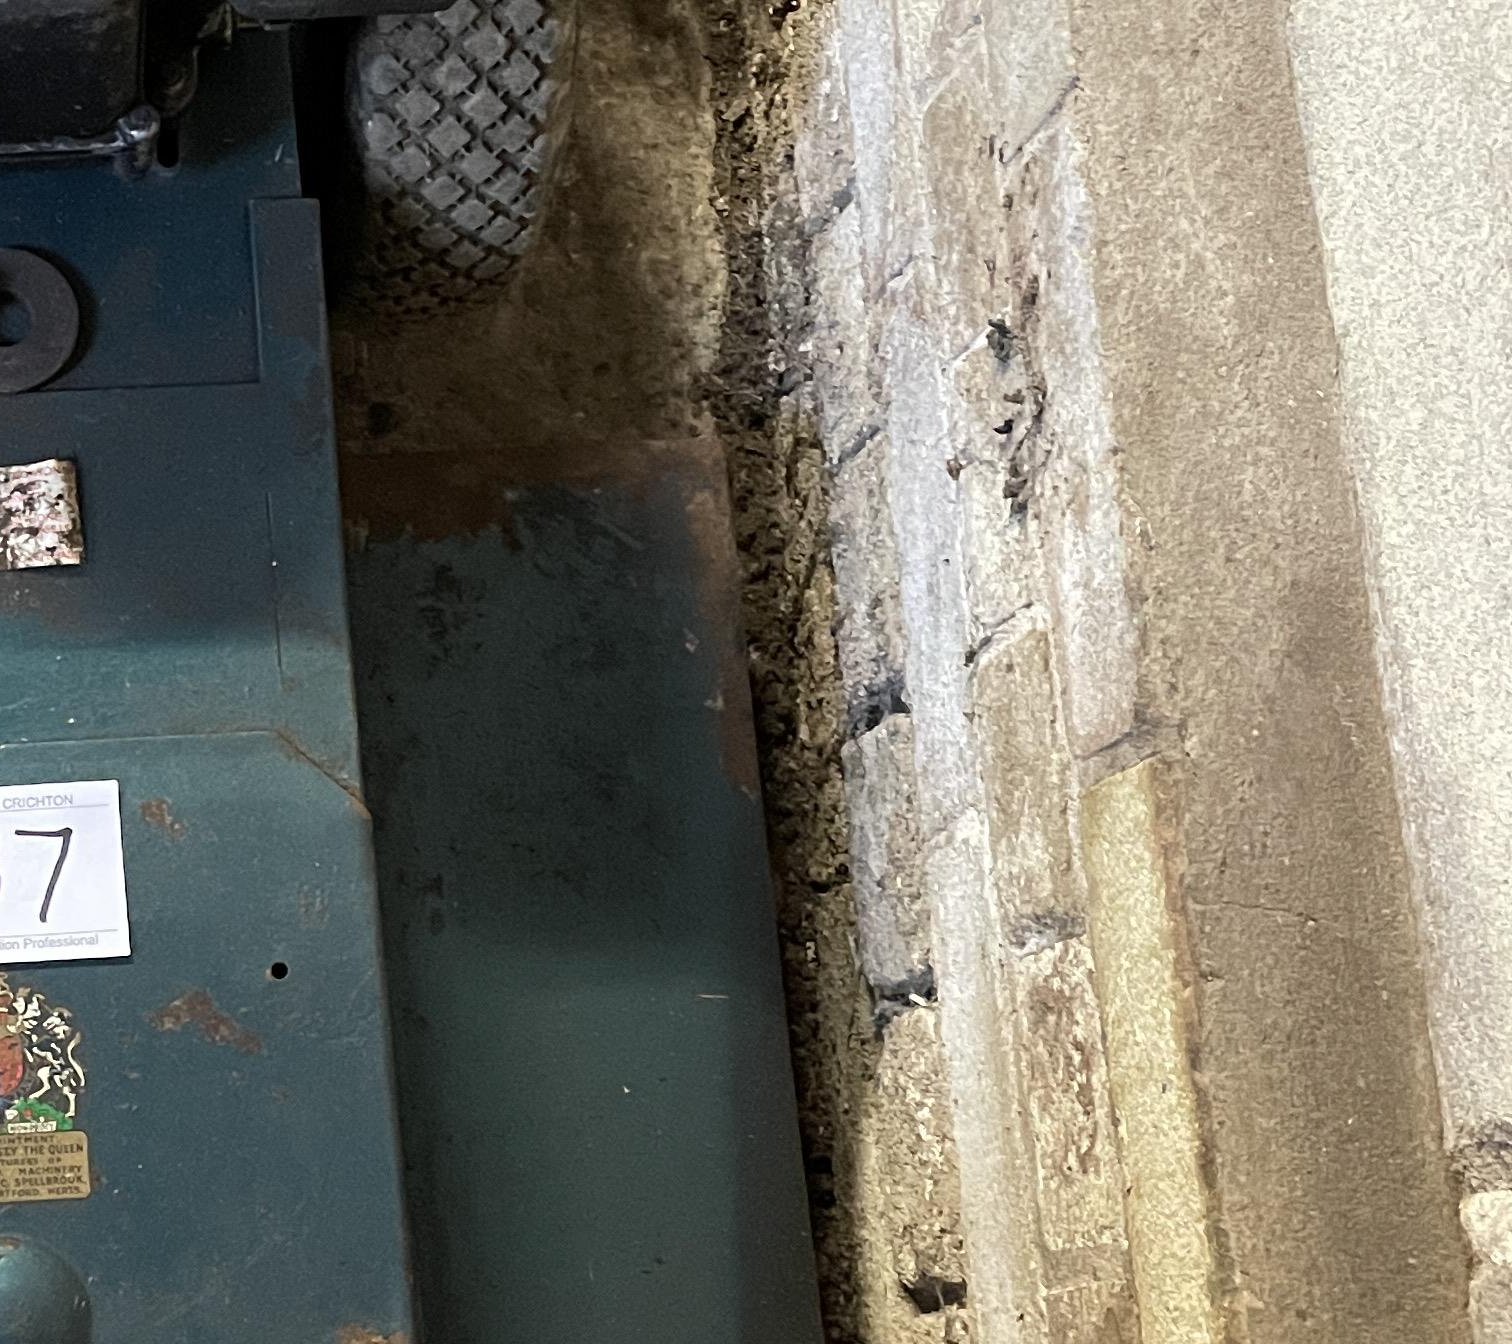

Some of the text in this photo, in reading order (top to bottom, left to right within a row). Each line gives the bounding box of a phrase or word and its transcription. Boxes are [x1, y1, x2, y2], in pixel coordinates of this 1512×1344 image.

[2, 794, 74, 809] CRICHTON
[23, 934, 99, 950] Professional
[23, 1145, 45, 1156] THE
[48, 1143, 84, 1155] QUEEN
[18, 1165, 82, 1176] MACHINERY
